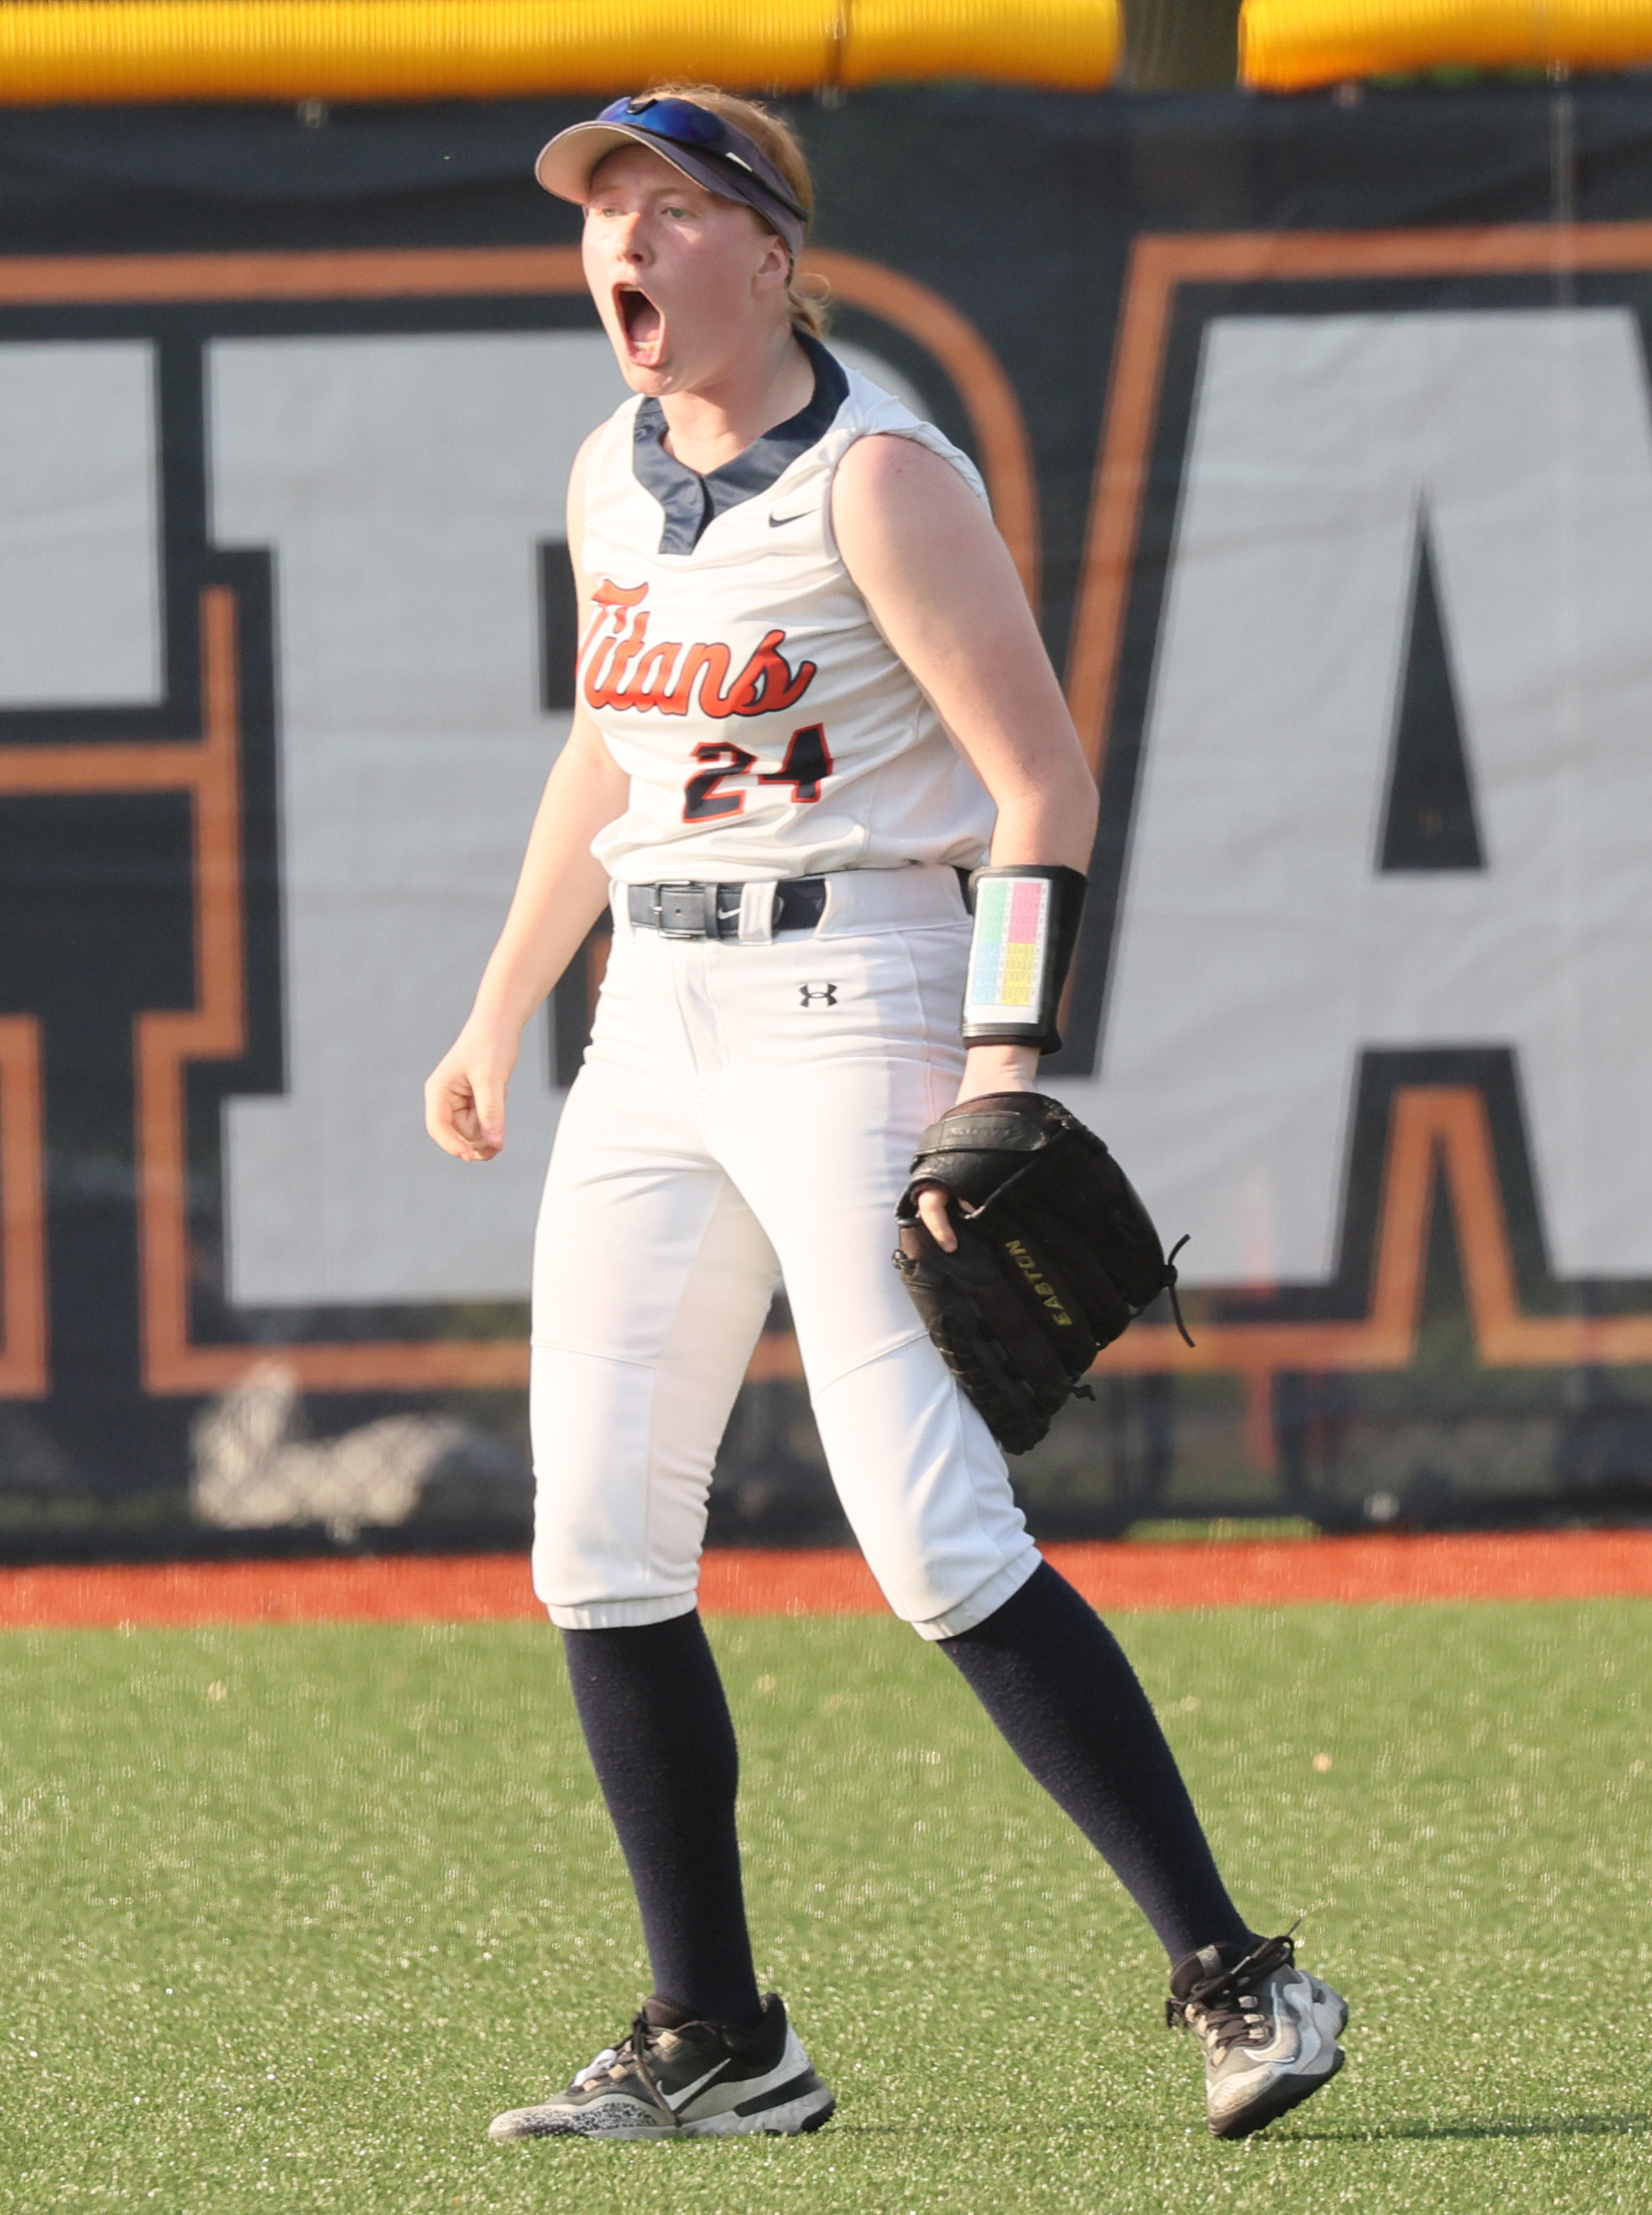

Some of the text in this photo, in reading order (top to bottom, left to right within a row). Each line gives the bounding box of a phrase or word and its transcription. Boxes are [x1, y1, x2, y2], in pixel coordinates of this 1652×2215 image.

[575, 578, 818, 719] Titans
[682, 722, 834, 824] 24
[1005, 1240, 1073, 1325] EASTON
